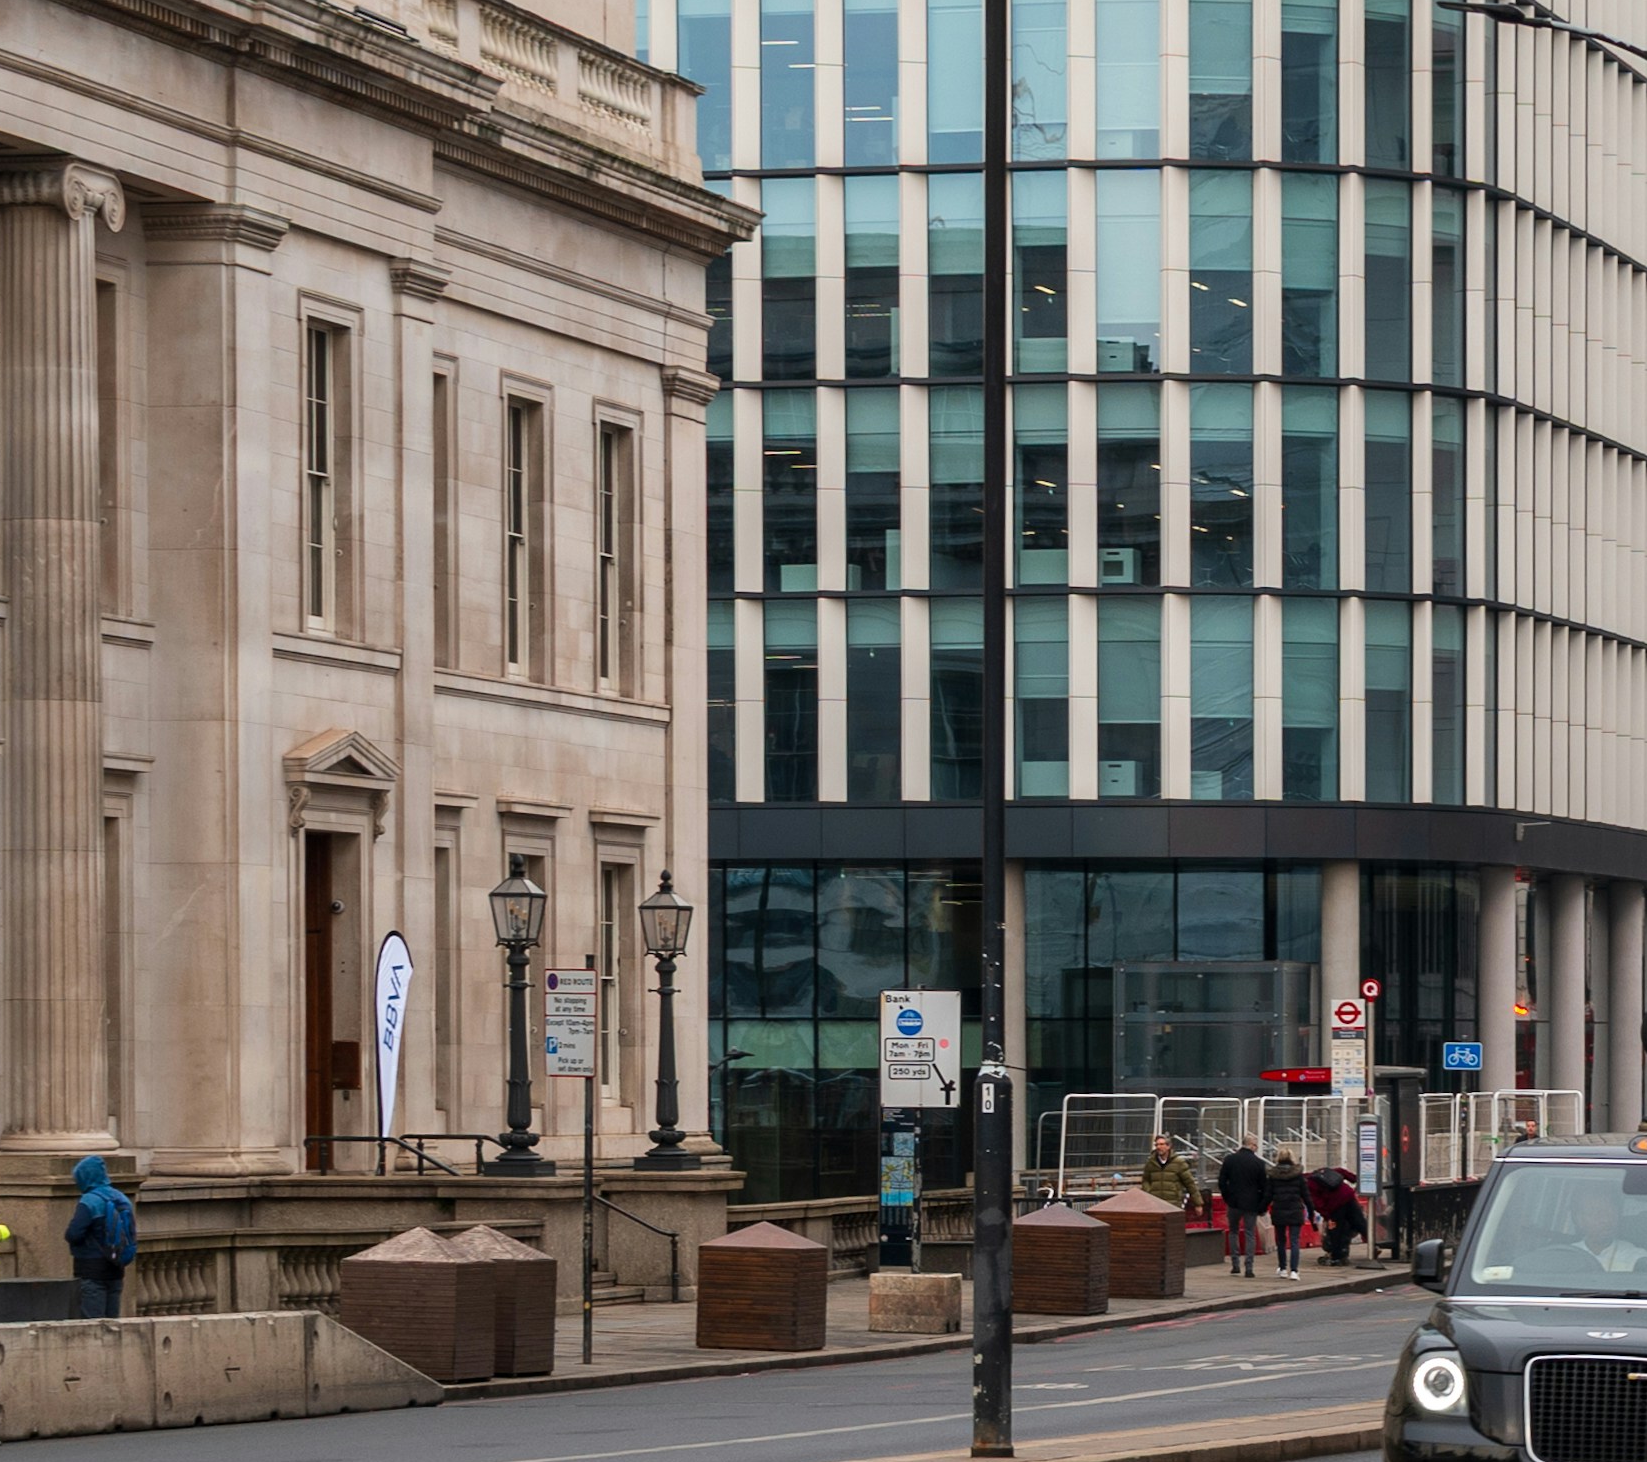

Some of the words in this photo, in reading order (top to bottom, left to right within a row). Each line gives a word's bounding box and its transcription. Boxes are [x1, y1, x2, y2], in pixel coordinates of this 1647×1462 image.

[573, 978, 594, 986] ROUTE
[1362, 981, 1378, 996] Q
[564, 997, 587, 1005] stopping
[885, 995, 911, 1003] Bank
[383, 964, 404, 1053] BBVA
[546, 1018, 564, 1026] Except
[891, 1041, 909, 1049] Mon
[917, 1041, 929, 1049] Fri
[914, 1050, 931, 1059] 7pm
[912, 1067, 927, 1076] yds
